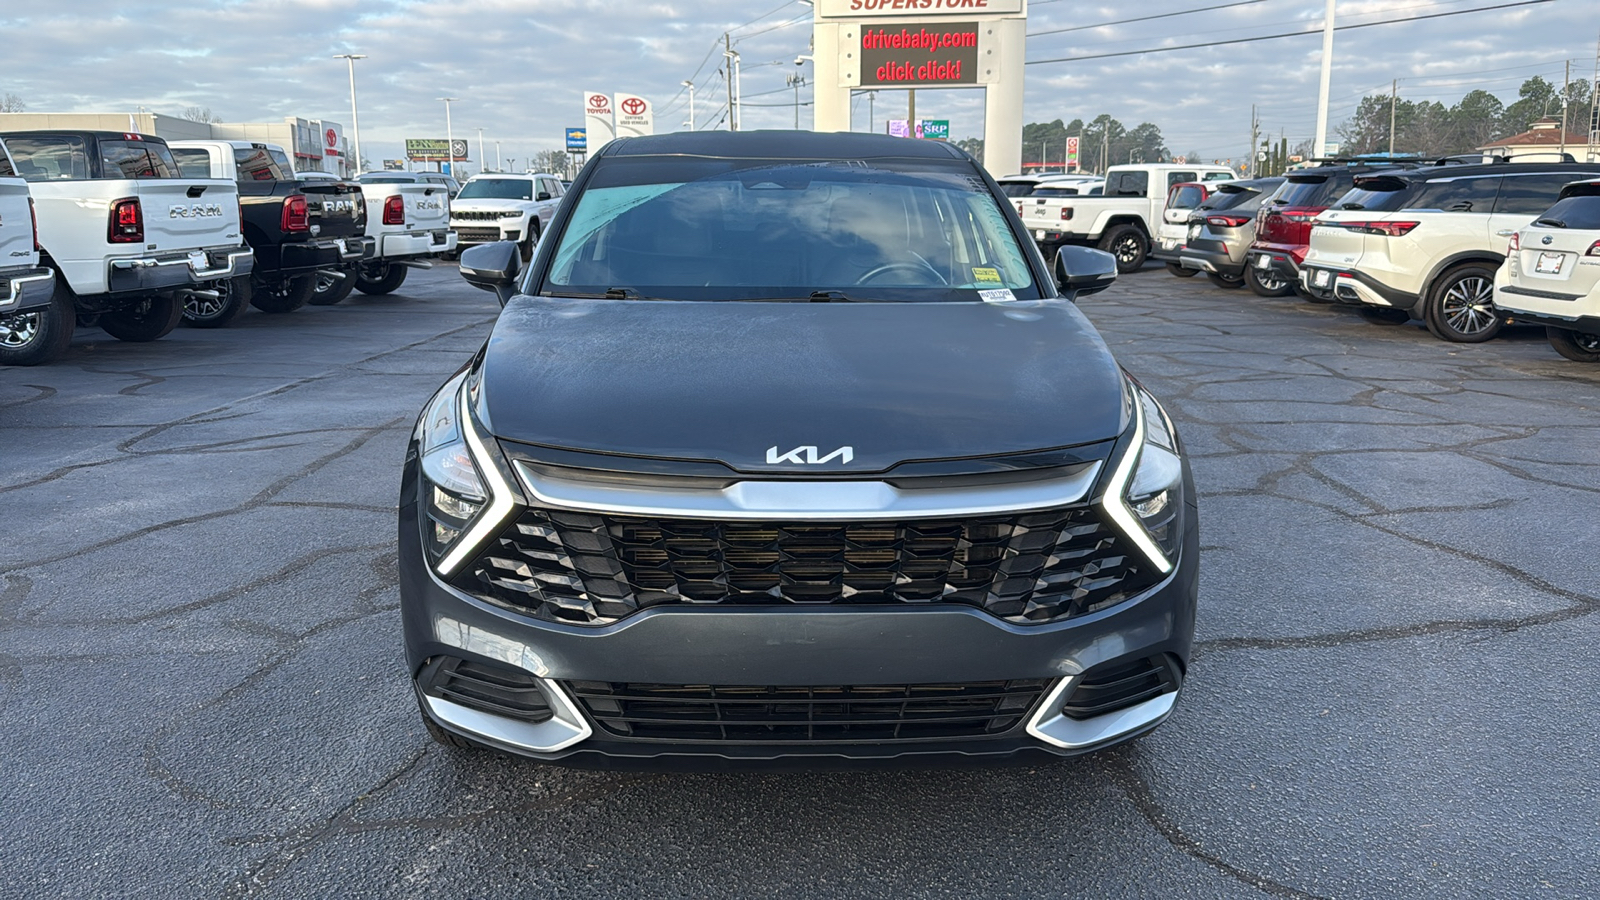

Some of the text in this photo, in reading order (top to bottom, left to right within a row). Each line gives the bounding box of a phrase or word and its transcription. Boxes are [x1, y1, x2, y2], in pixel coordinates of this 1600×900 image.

[850, 0, 988, 11] SUPERSTORE
[862, 28, 977, 53] drivebaby.com
[876, 60, 962, 81] click click!
[924, 124, 947, 133] SRP
[168, 203, 223, 218] RAM
[323, 200, 355, 212] RAM
